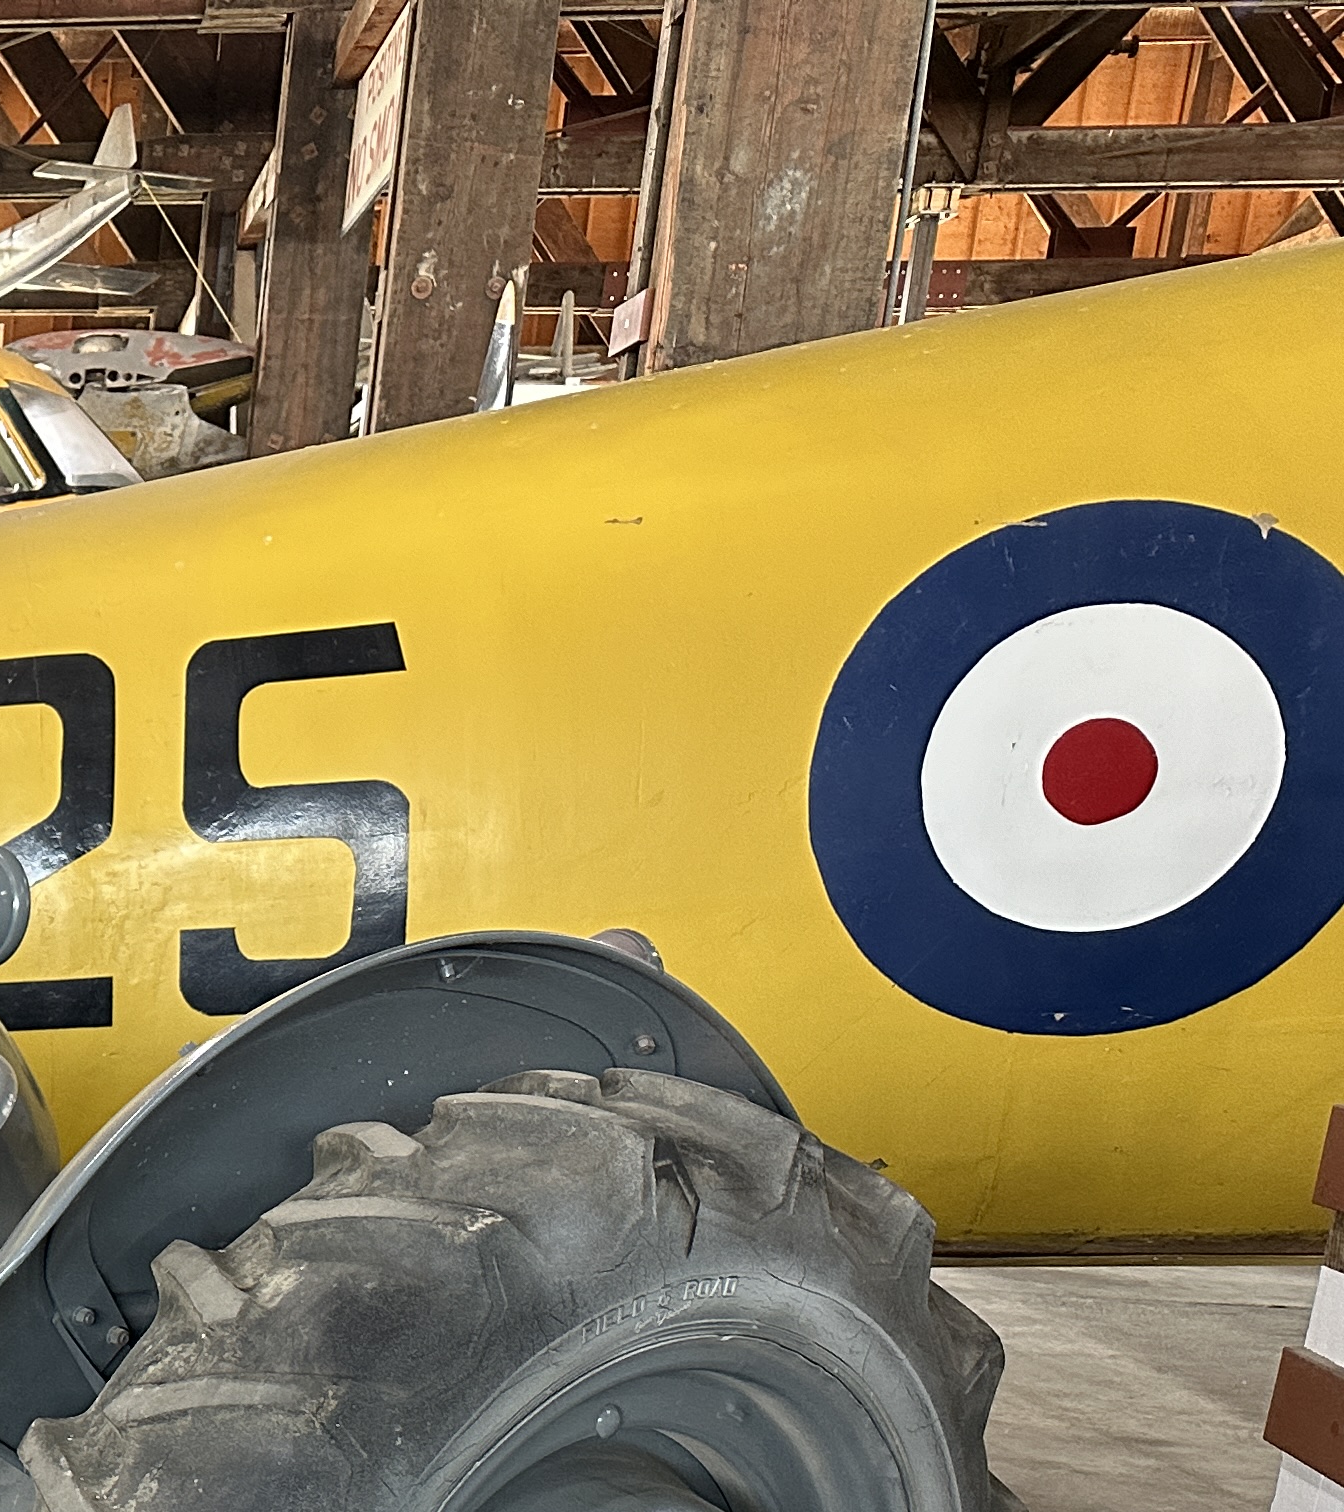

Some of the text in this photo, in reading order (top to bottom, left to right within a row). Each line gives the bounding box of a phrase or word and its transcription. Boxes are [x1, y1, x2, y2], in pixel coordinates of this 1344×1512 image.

[347, 135, 367, 208] NO
[582, 1298, 647, 1345] FIELD
[682, 1276, 738, 1302] ROAD
